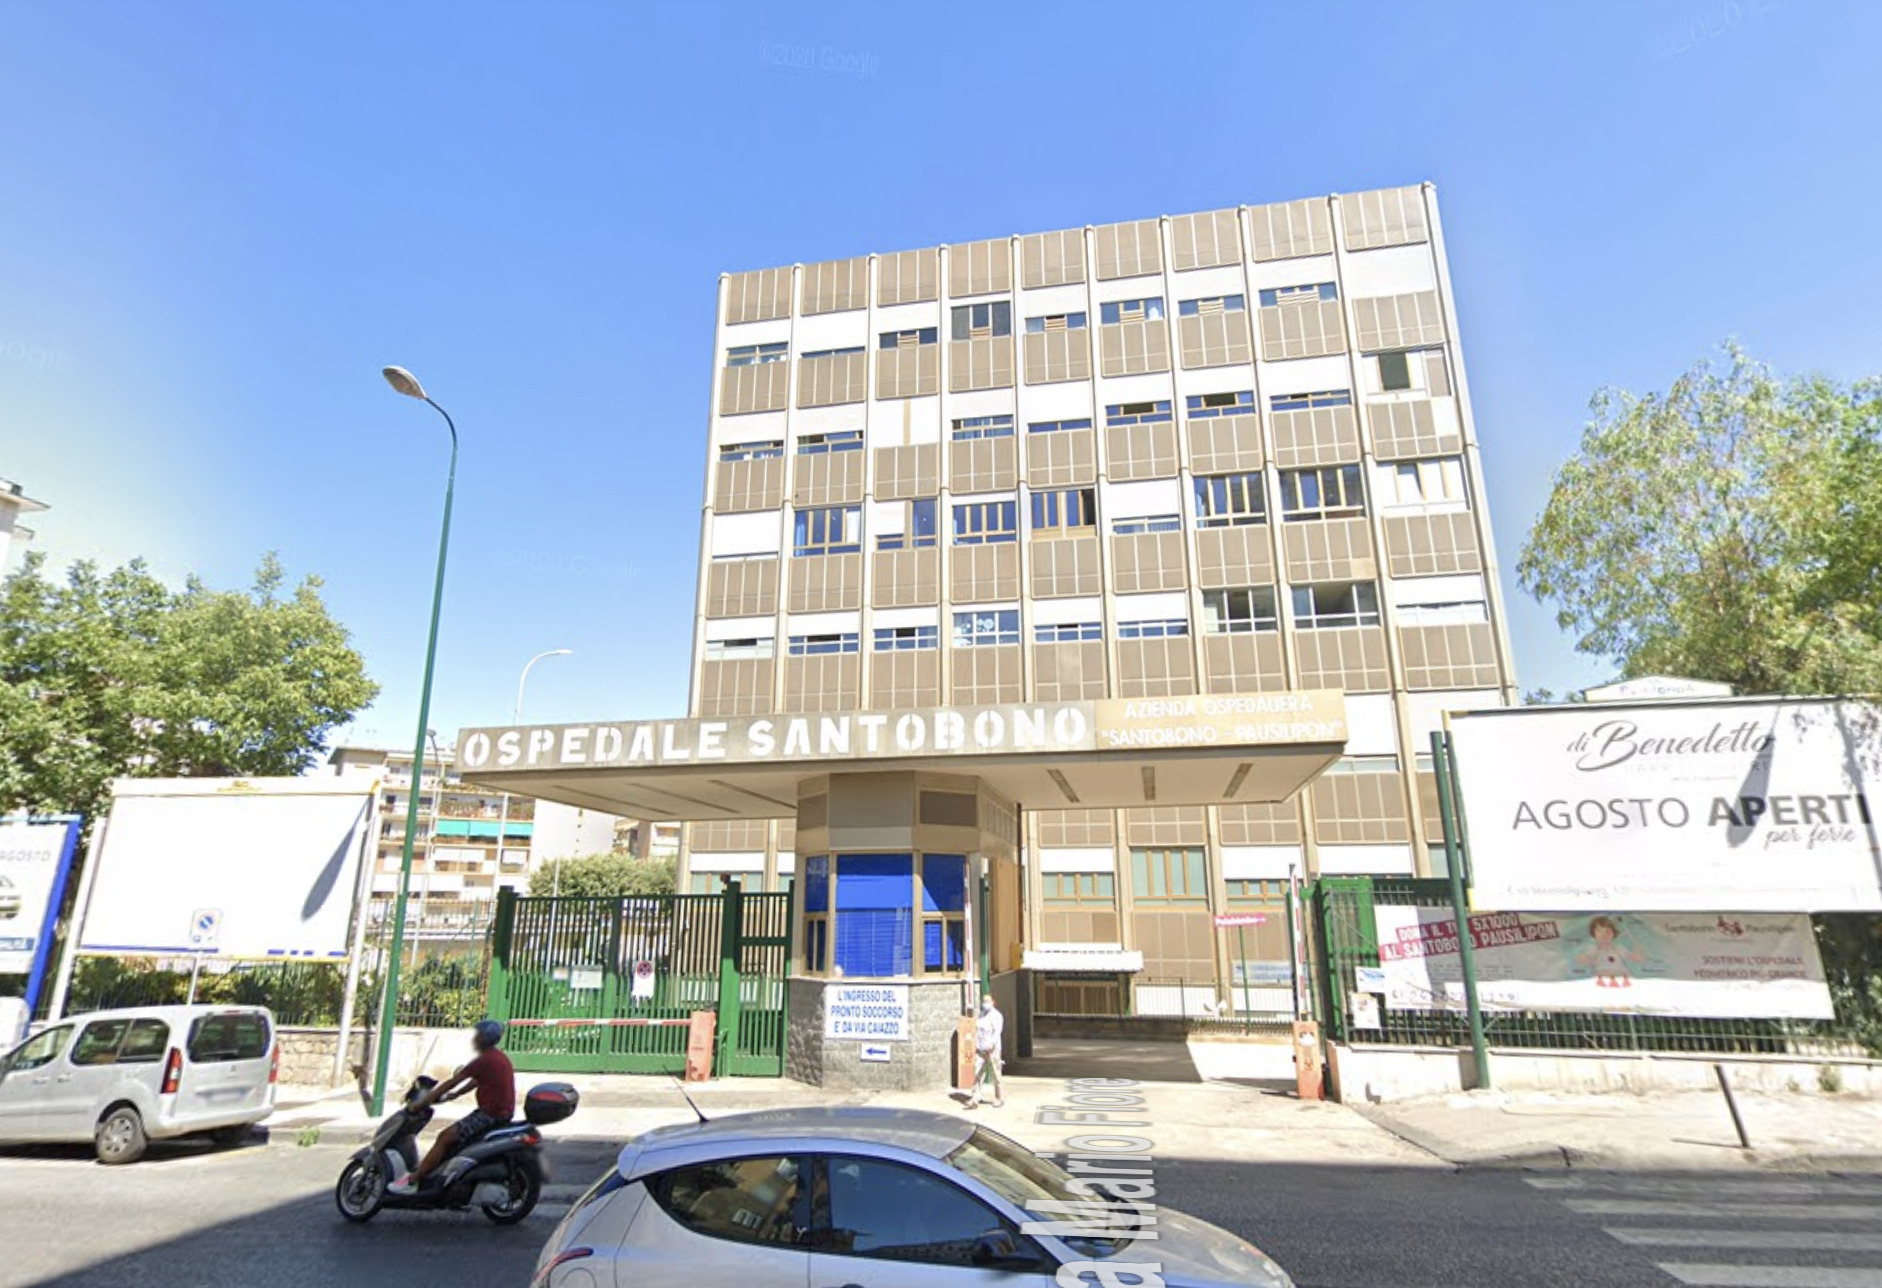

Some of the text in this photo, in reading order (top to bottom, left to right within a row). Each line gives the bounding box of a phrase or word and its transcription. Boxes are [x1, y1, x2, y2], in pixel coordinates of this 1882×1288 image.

[1124, 695, 1314, 719] AZIENDA OSPEDALIERA
[463, 707, 1087, 767] OSPEDALE SANTOBONO
[1566, 719, 1773, 773] di Benedetto
[1512, 793, 1872, 831] AGOSTO APERTI
[1764, 822, 1857, 850] per ferie
[1384, 922, 1558, 959] AL SANTOBOO PAUSILIPON
[1398, 925, 1429, 941] DONA
[1430, 923, 1444, 937] IL
[1471, 913, 1518, 932] 5X1000
[837, 989, 897, 1003] L'INGRESSO DEL
[830, 1004, 904, 1020] PRONTO SOCCORSO
[842, 1020, 853, 1033] DA
[853, 1020, 866, 1034] VIA
[867, 1021, 899, 1035] CAIAZZO
